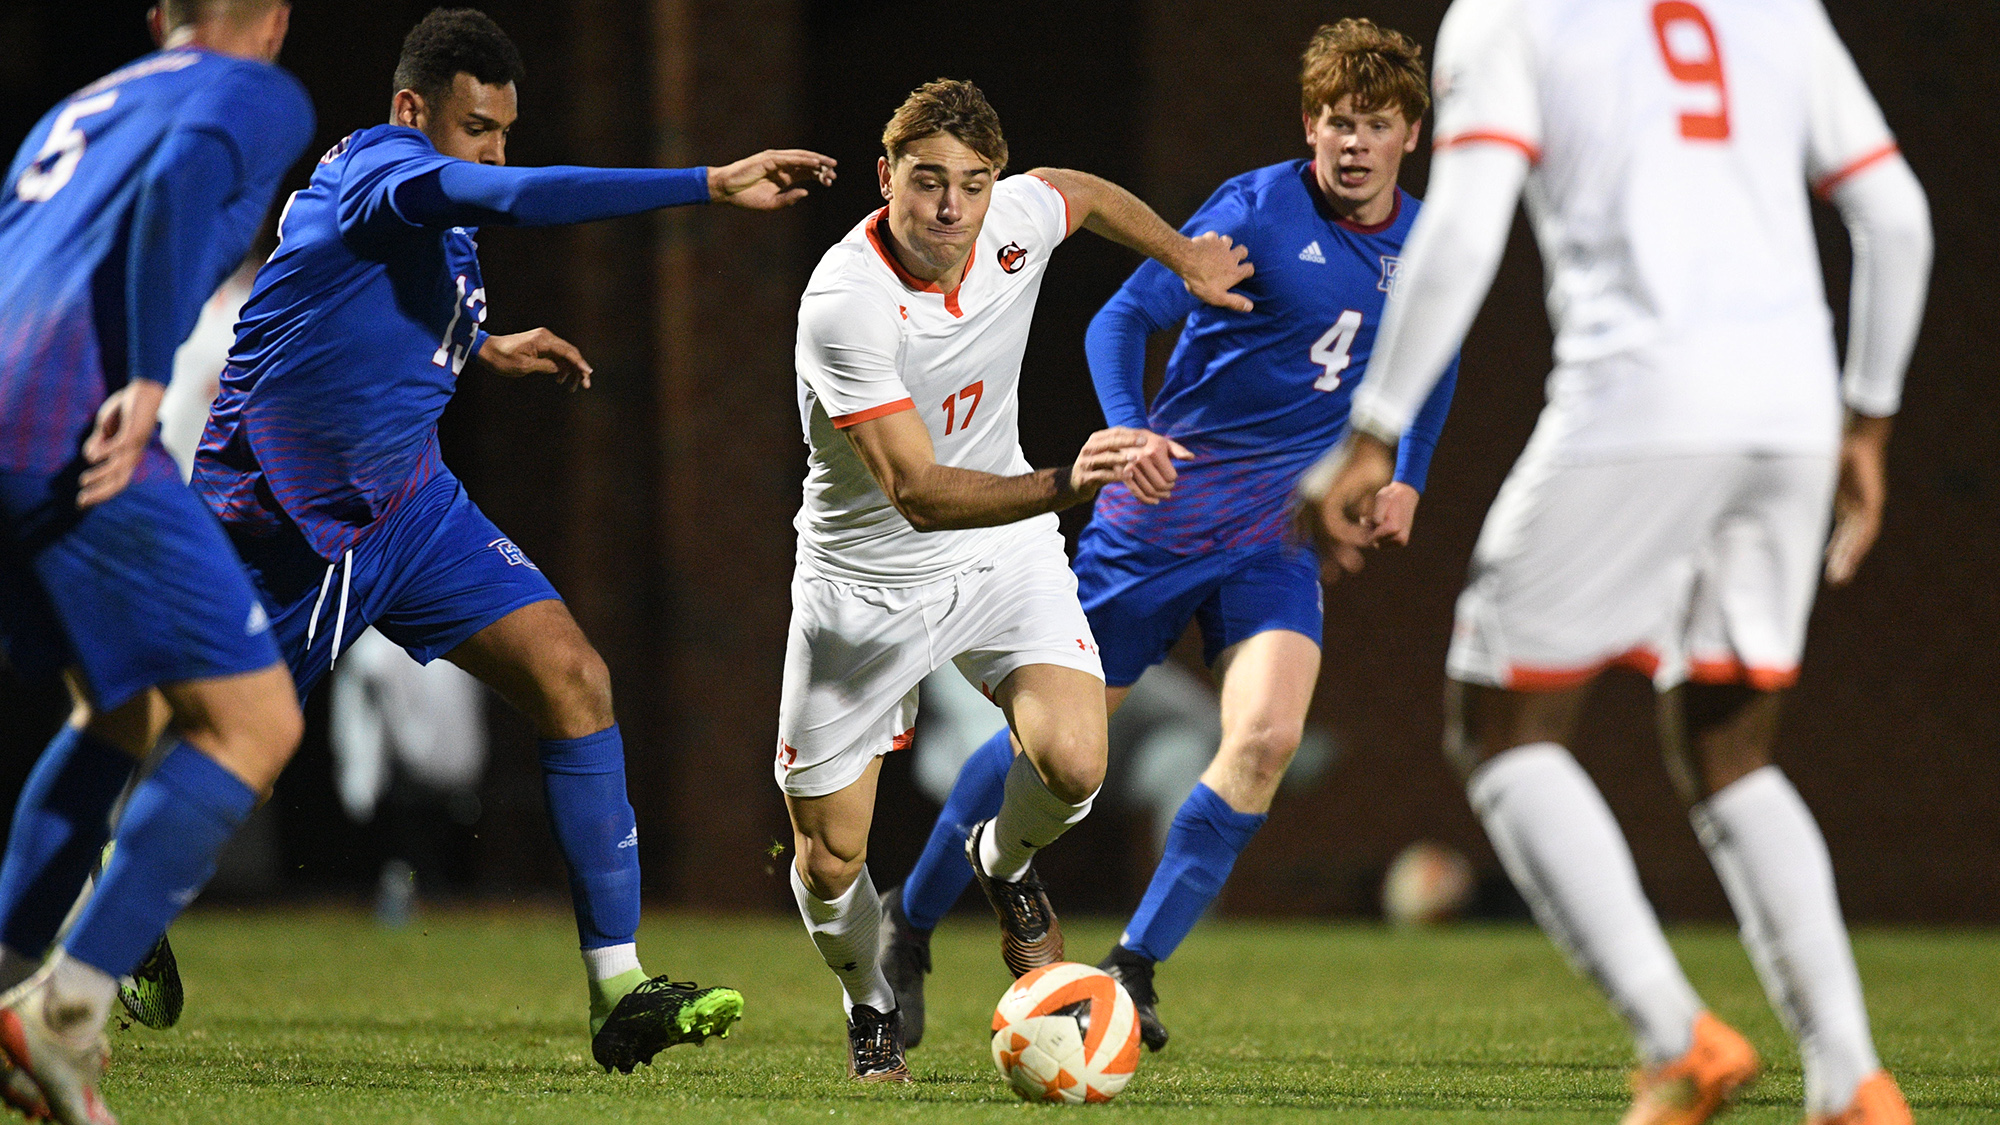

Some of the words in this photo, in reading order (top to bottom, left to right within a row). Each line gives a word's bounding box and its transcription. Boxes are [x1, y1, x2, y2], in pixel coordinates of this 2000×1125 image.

[1650, 0, 1730, 141] 9
[15, 89, 119, 202] 5
[432, 274, 487, 377] 13
[1310, 309, 1363, 392] 4
[942, 379, 984, 436] 17
